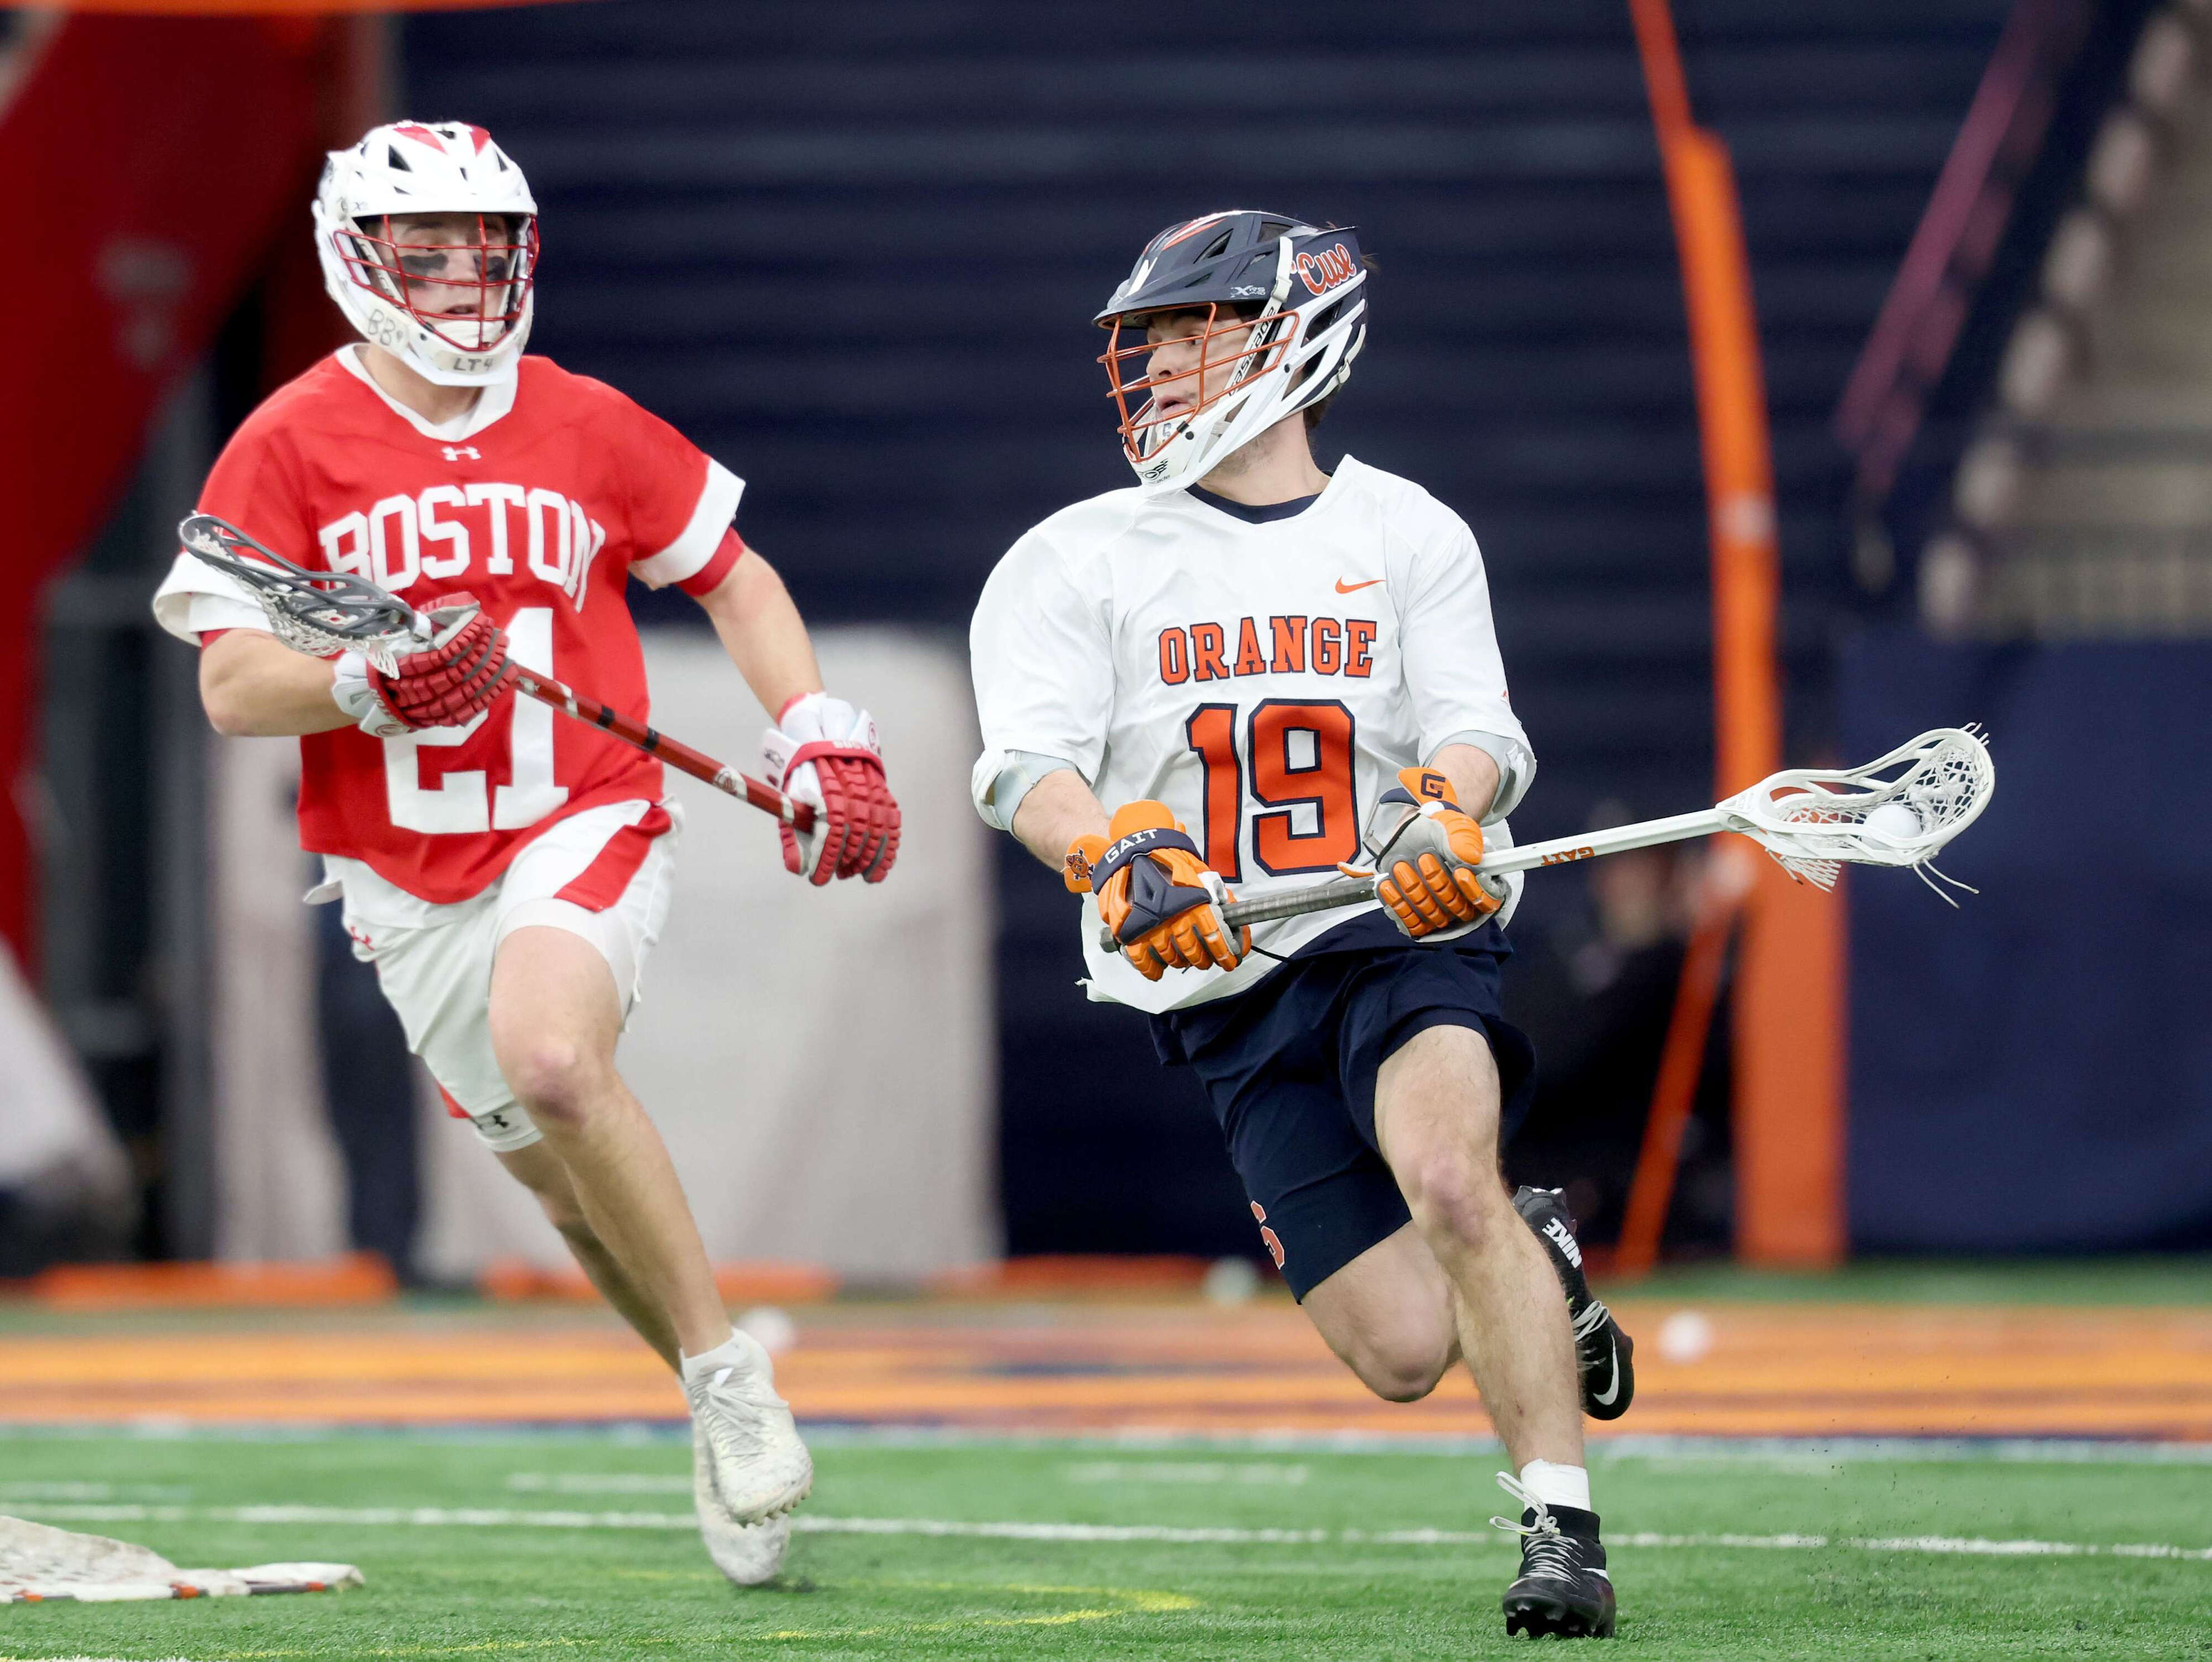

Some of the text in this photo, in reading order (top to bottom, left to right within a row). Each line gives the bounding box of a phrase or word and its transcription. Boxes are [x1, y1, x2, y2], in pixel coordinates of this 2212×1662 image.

[318, 482, 606, 613] BOSTON
[1159, 615, 1377, 686] ORANGE
[1186, 698, 1361, 883] 19
[1104, 828, 1158, 864] GAIT
[1541, 846, 1595, 866] GAIT
[1542, 1217, 1583, 1268] NIKE
